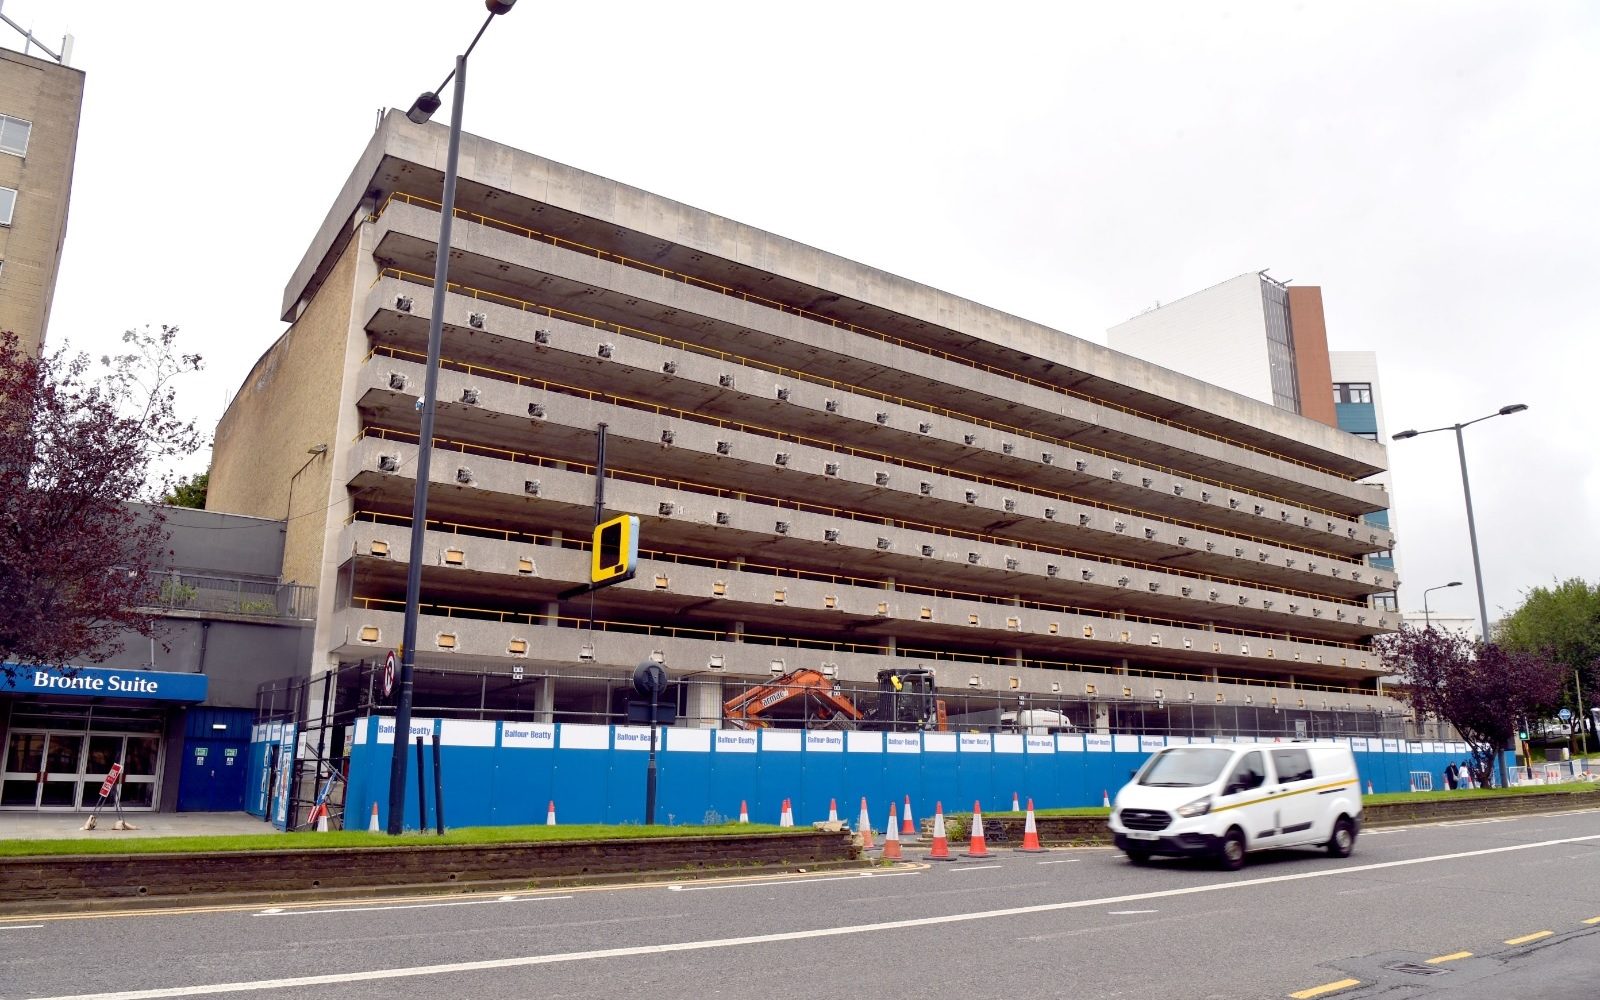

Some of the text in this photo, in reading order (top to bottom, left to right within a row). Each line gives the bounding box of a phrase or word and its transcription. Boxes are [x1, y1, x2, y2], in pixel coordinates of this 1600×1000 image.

[33, 671, 158, 693] Bronte Suite
[504, 729, 552, 740] Balfour Beatty
[616, 733, 659, 742] Balfour Beay
[717, 736, 756, 745] Balfour Beatty
